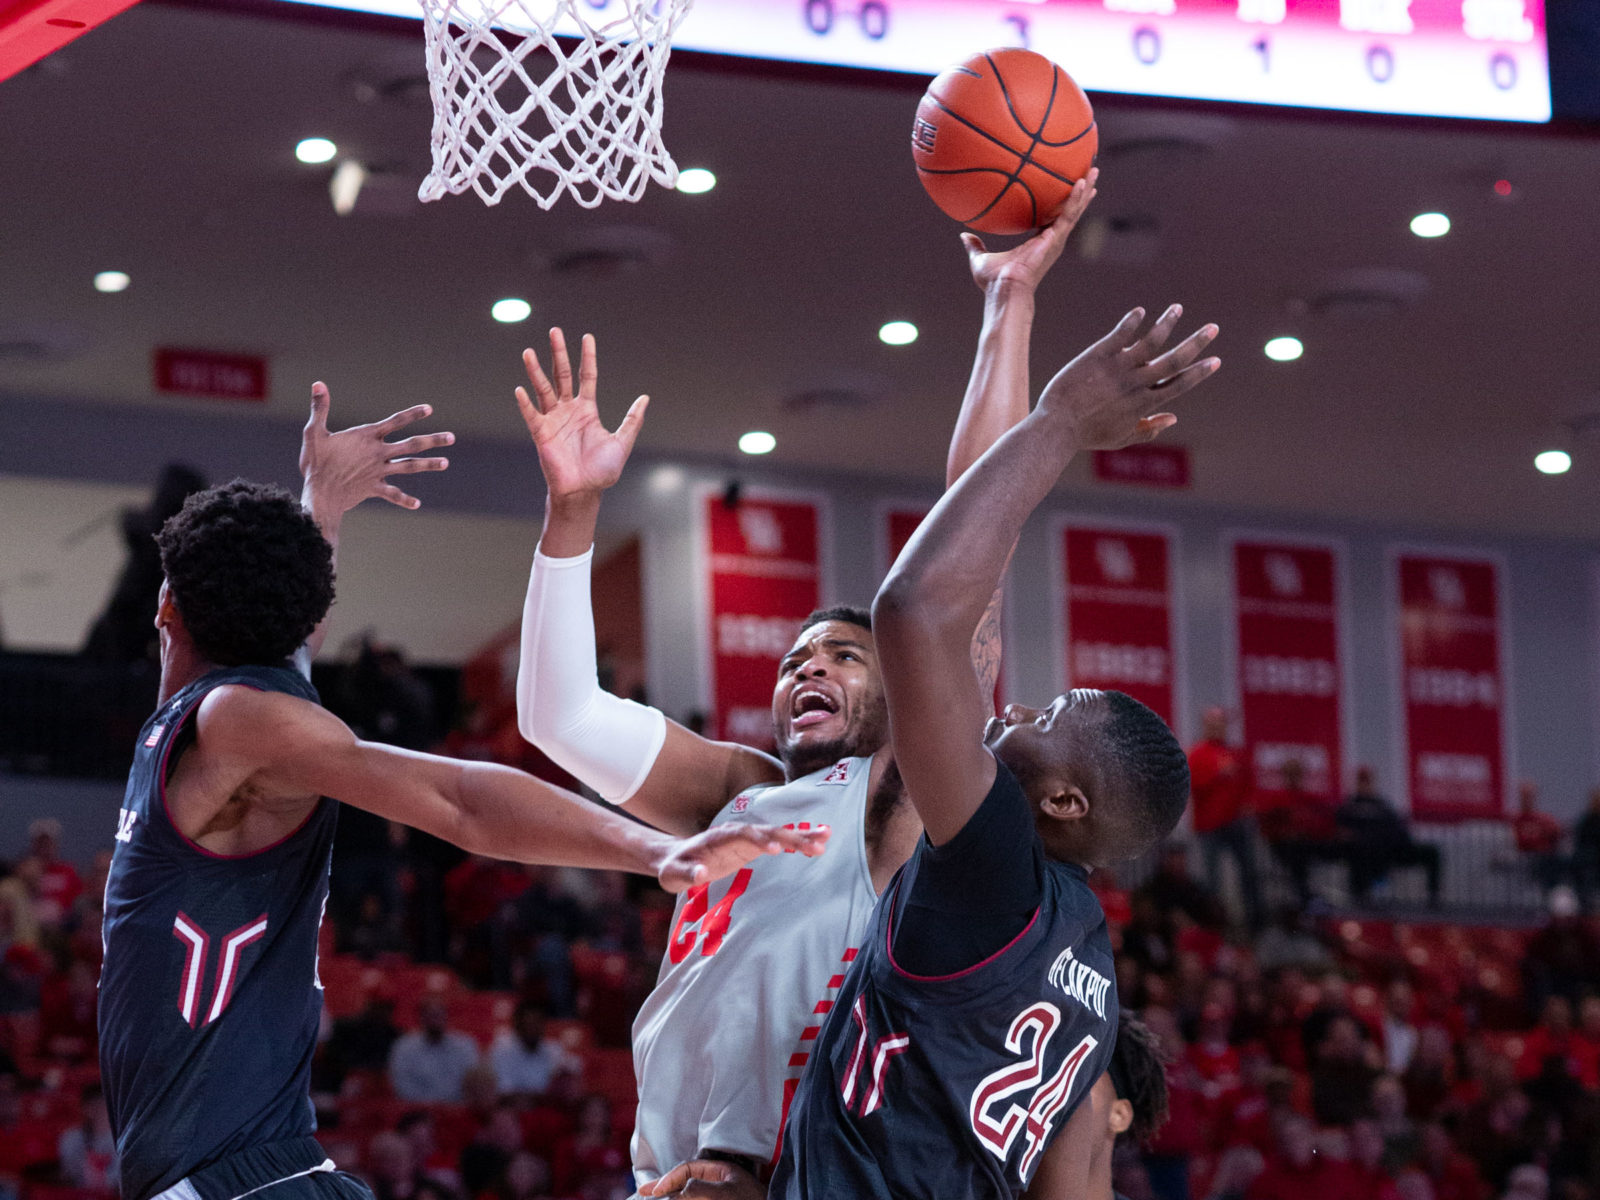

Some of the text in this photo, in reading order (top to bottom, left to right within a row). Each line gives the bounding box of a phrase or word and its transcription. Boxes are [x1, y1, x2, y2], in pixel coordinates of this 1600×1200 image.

[1132, 26, 1162, 65] 0
[1366, 44, 1395, 84] 0
[1489, 52, 1519, 91] 0
[969, 1001, 1098, 1185] 24
